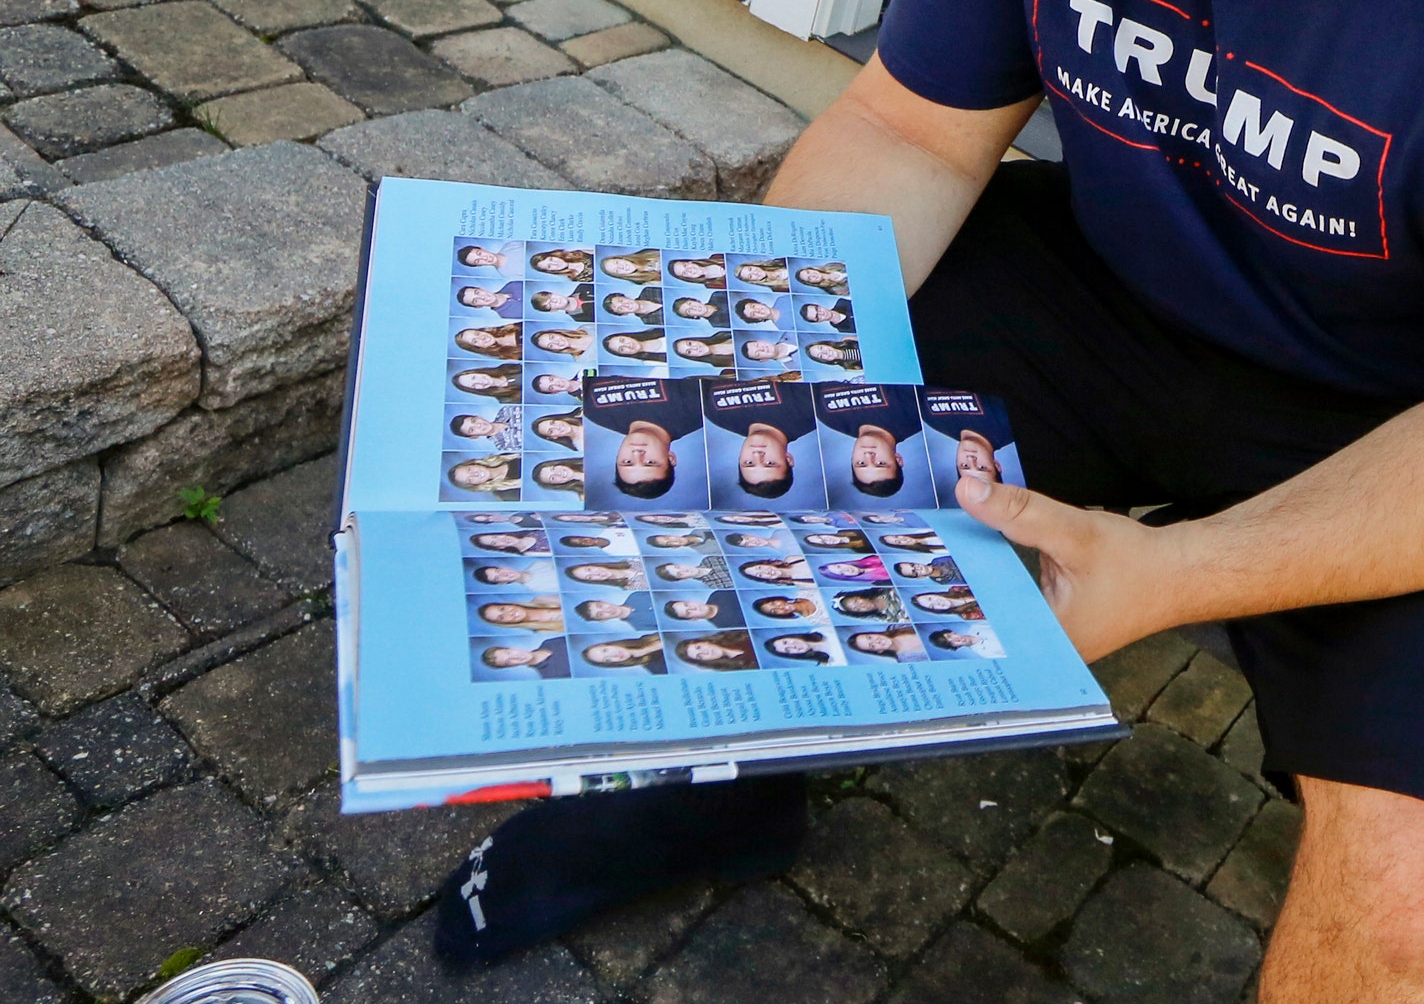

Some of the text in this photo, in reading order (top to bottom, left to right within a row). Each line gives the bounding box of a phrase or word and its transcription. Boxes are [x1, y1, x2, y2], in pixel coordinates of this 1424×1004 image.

[1056, 66, 1111, 112] MAKE
[1265, 196, 1357, 238] AGAIN!
[597, 389, 660, 404] TRUMP
[717, 392, 775, 406] TRUMP
[828, 394, 881, 409] TRUMP
[931, 402, 978, 412] TRUMP
